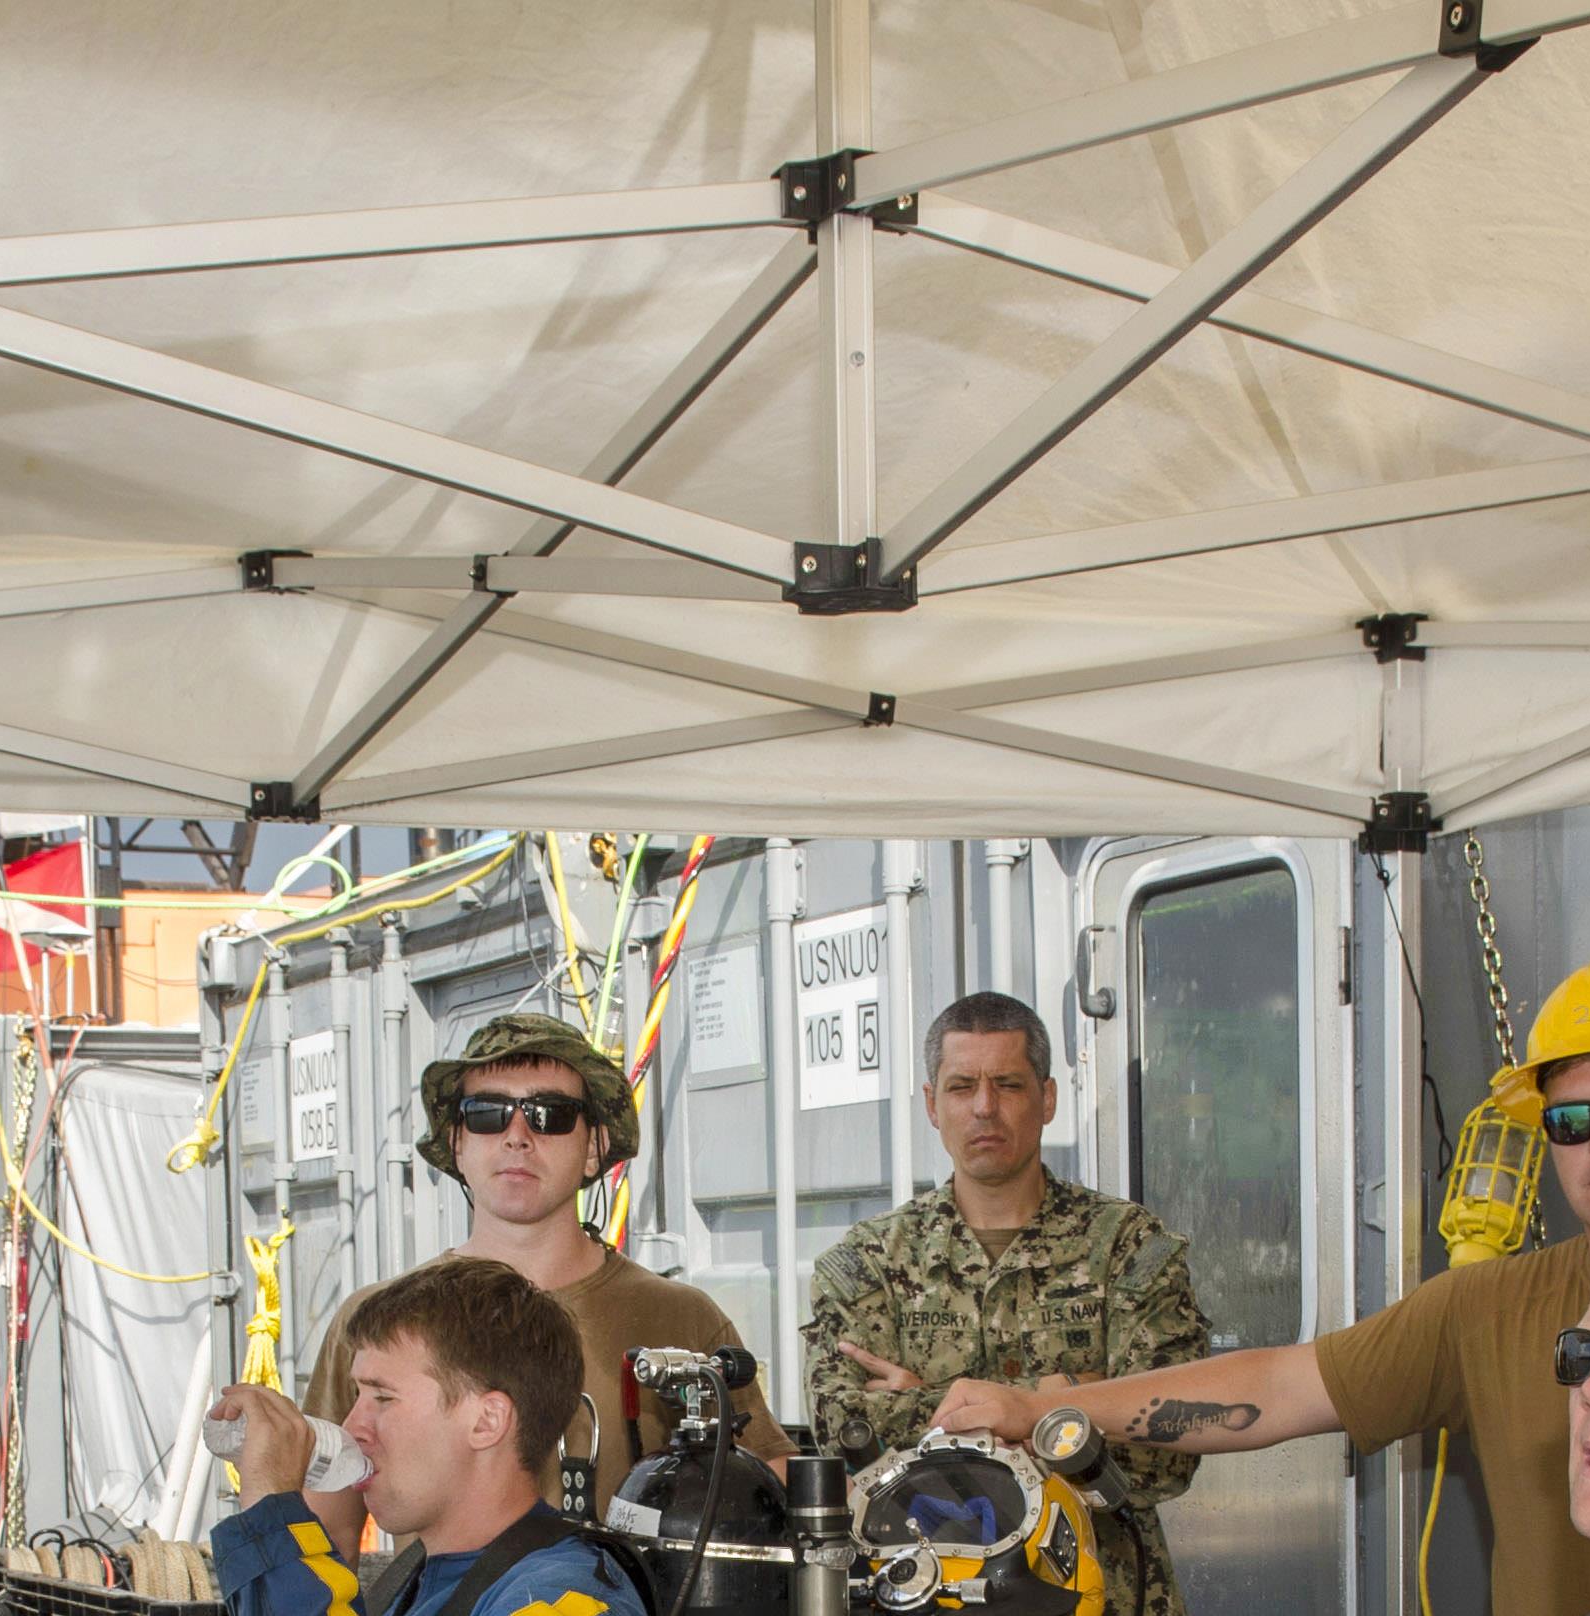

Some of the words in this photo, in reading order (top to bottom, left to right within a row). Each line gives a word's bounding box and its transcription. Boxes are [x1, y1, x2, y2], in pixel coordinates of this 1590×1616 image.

[806, 1015, 842, 1064] 105
[862, 1010, 877, 1063] 5
[899, 1310, 968, 1328] EVEROSKY
